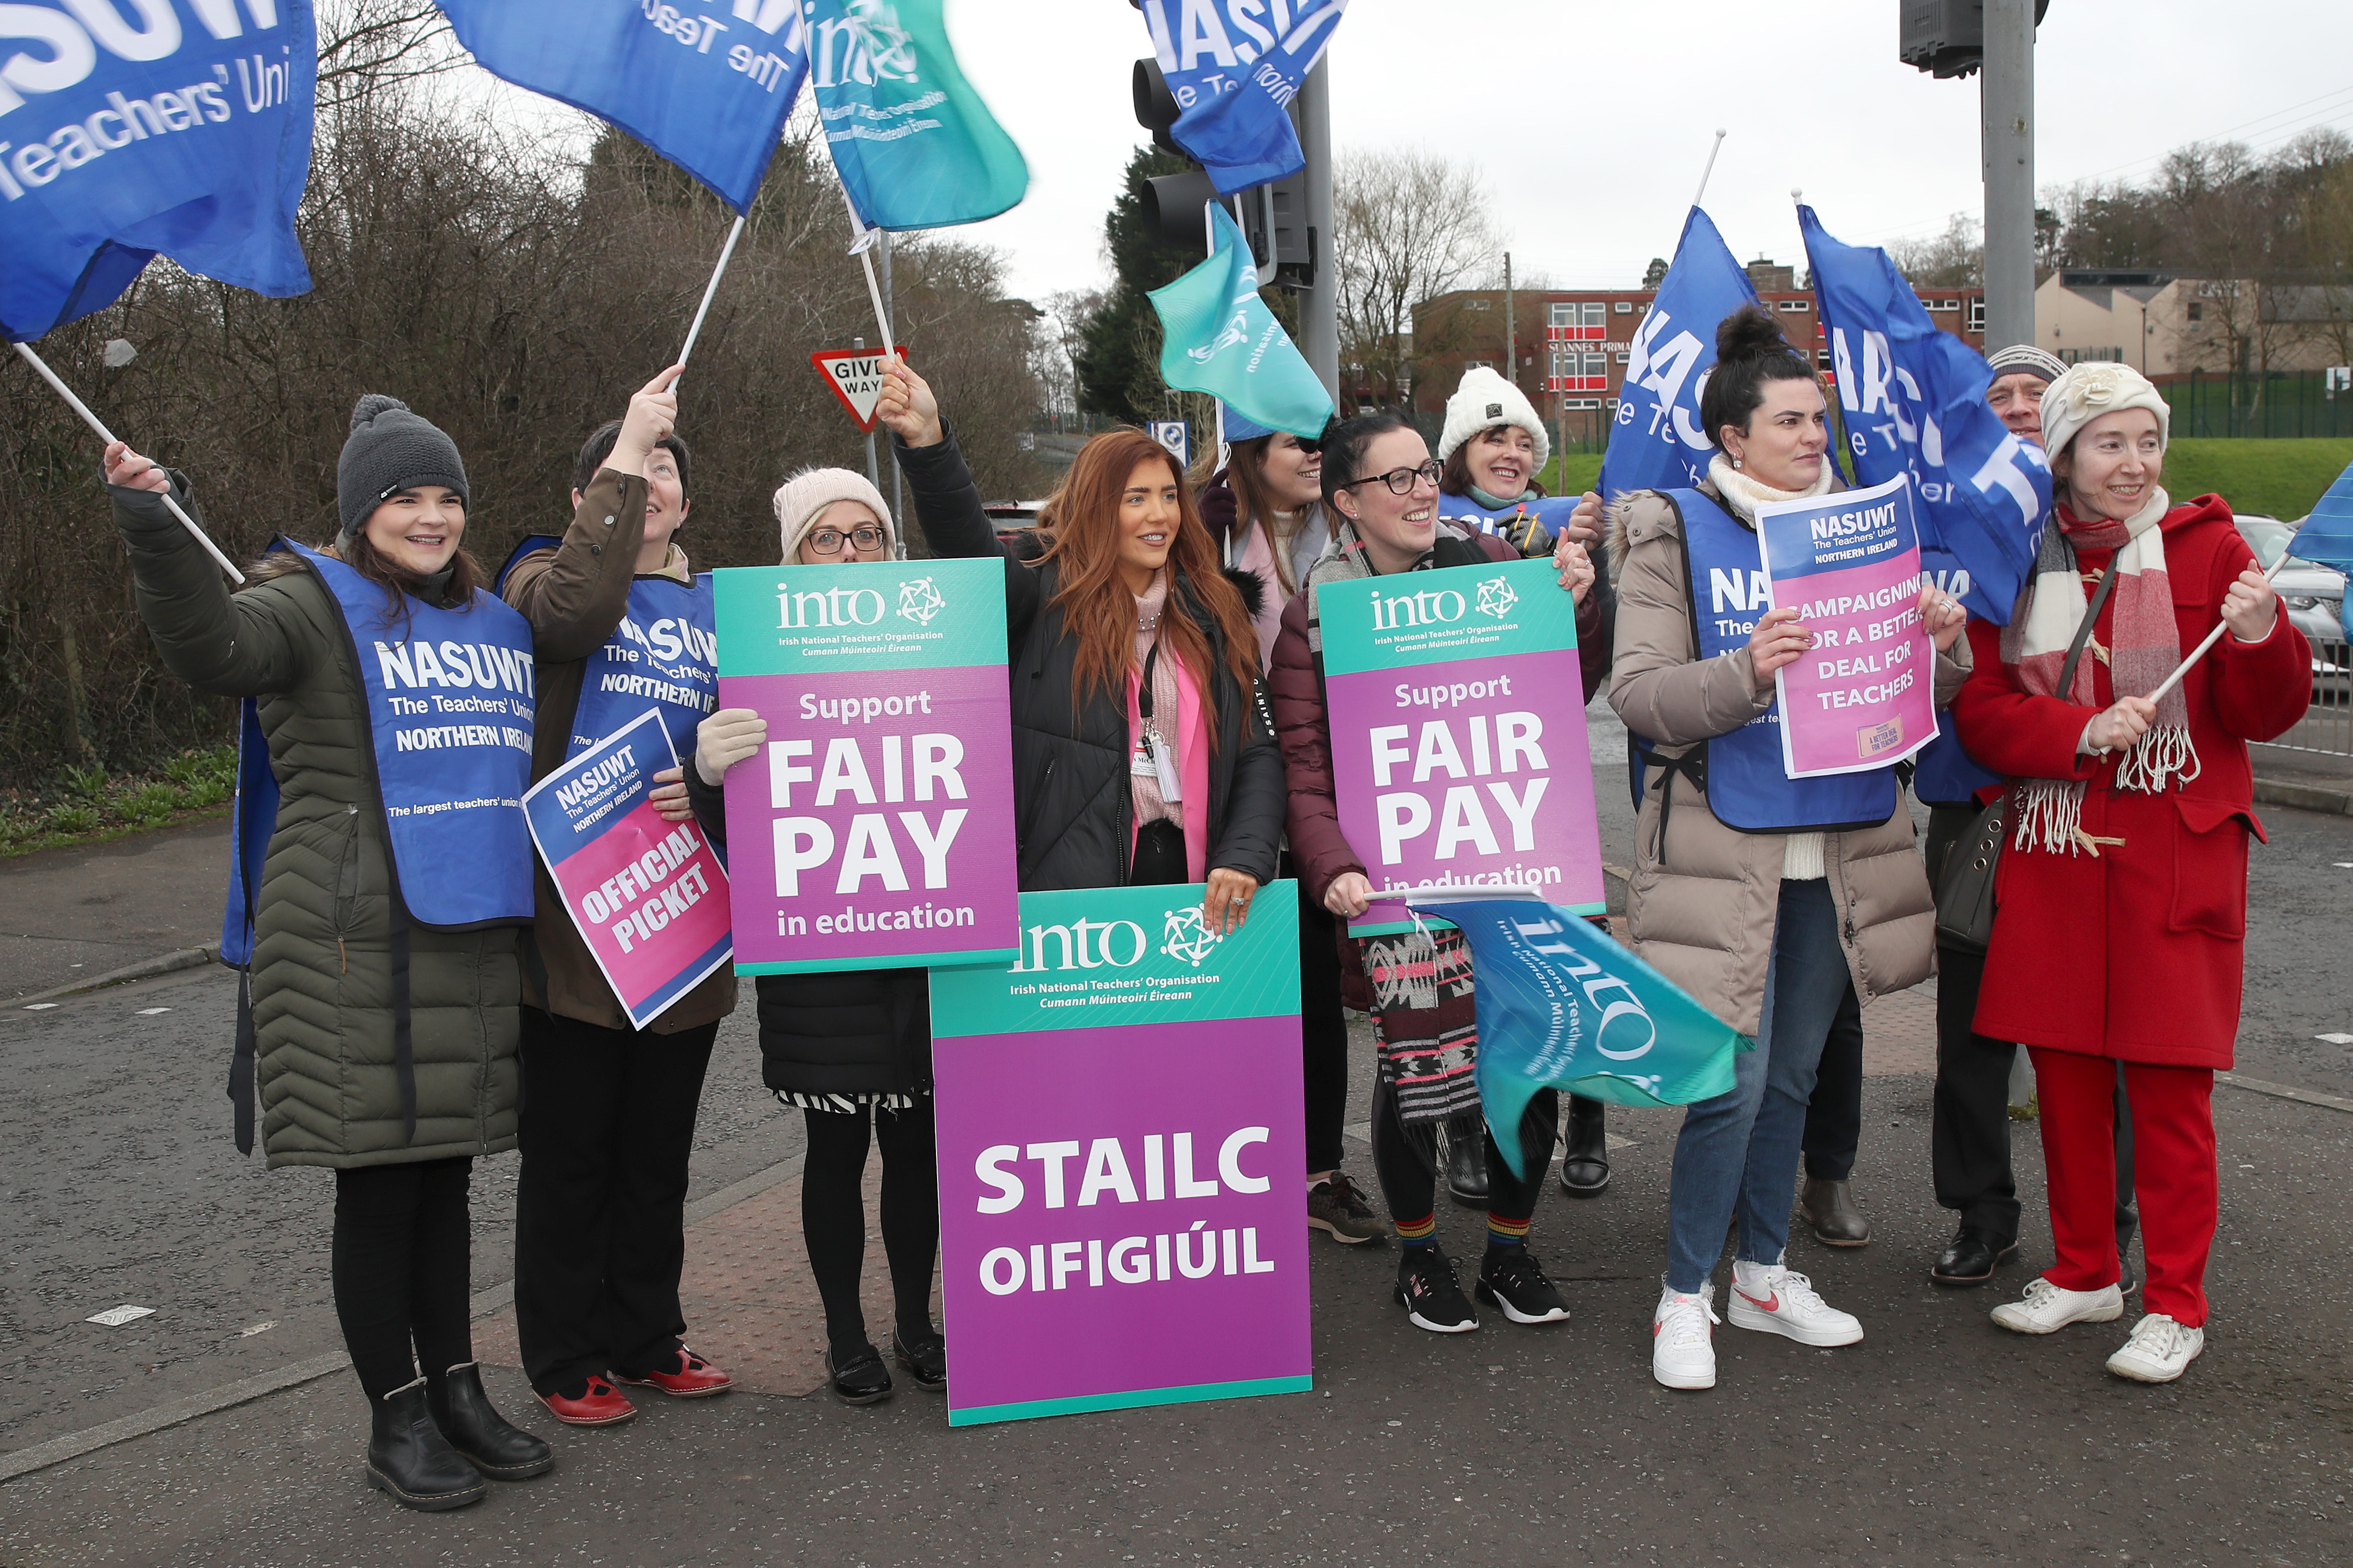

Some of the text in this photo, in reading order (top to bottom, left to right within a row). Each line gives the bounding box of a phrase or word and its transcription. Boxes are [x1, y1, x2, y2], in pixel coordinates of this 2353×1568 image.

[845, 380, 879, 393] WAY
[1810, 501, 1895, 540] NASUWT
[1813, 526, 1897, 550] The Teachers' Union
[1815, 538, 1898, 565] NORTHERN IRELAND
[776, 582, 885, 629] into
[1370, 590, 1466, 630] into
[779, 631, 944, 646] Irish National Teachers' Organisation
[1375, 623, 1519, 645] Irish National Teachers' Organisation
[1715, 619, 1754, 636] The
[1845, 627, 1864, 645] A
[604, 645, 711, 684] The Teachers'
[802, 648, 838, 656] Cumann
[1395, 643, 1427, 652] Cumann
[1818, 640, 1911, 679] DEAL FOR
[374, 640, 534, 699] NASUWT
[601, 674, 700, 710] NORTHERN
[799, 690, 932, 724] Support
[1394, 673, 1512, 709] Support
[1817, 668, 1913, 710] TEACHERS
[388, 695, 534, 723] The Teachers' Union
[1255, 692, 1272, 726] SAINT
[395, 725, 501, 752] NORTHERN
[574, 736, 592, 746] The
[1369, 711, 1549, 787] FAIR
[1871, 735, 1898, 752] FOR TEACHERS
[1873, 732, 1888, 742] BETTER
[1888, 727, 1897, 737] DEAL
[555, 744, 635, 810] NASUWT
[768, 733, 968, 808] FAIR
[388, 806, 410, 817] The
[414, 801, 451, 815] largest
[454, 797, 500, 810] teachers'
[566, 768, 640, 819] The Teachers' Union
[573, 780, 642, 833] NORTHERN IRELAND
[1376, 777, 1550, 865] PAY
[772, 809, 969, 897] PAY
[581, 822, 701, 925] OFFICIAL
[611, 861, 709, 955] PICKET
[777, 902, 974, 936] in education
[1010, 973, 1219, 995] Irish National Teachers' Organisation
[1509, 916, 1656, 1060] into
[1521, 949, 1573, 997] National
[1040, 989, 1192, 1008] Cumann Múinteoirí Éireann
[975, 1126, 1271, 1215] STAILC
[979, 1220, 1275, 1296] OIFIGIÚIL
